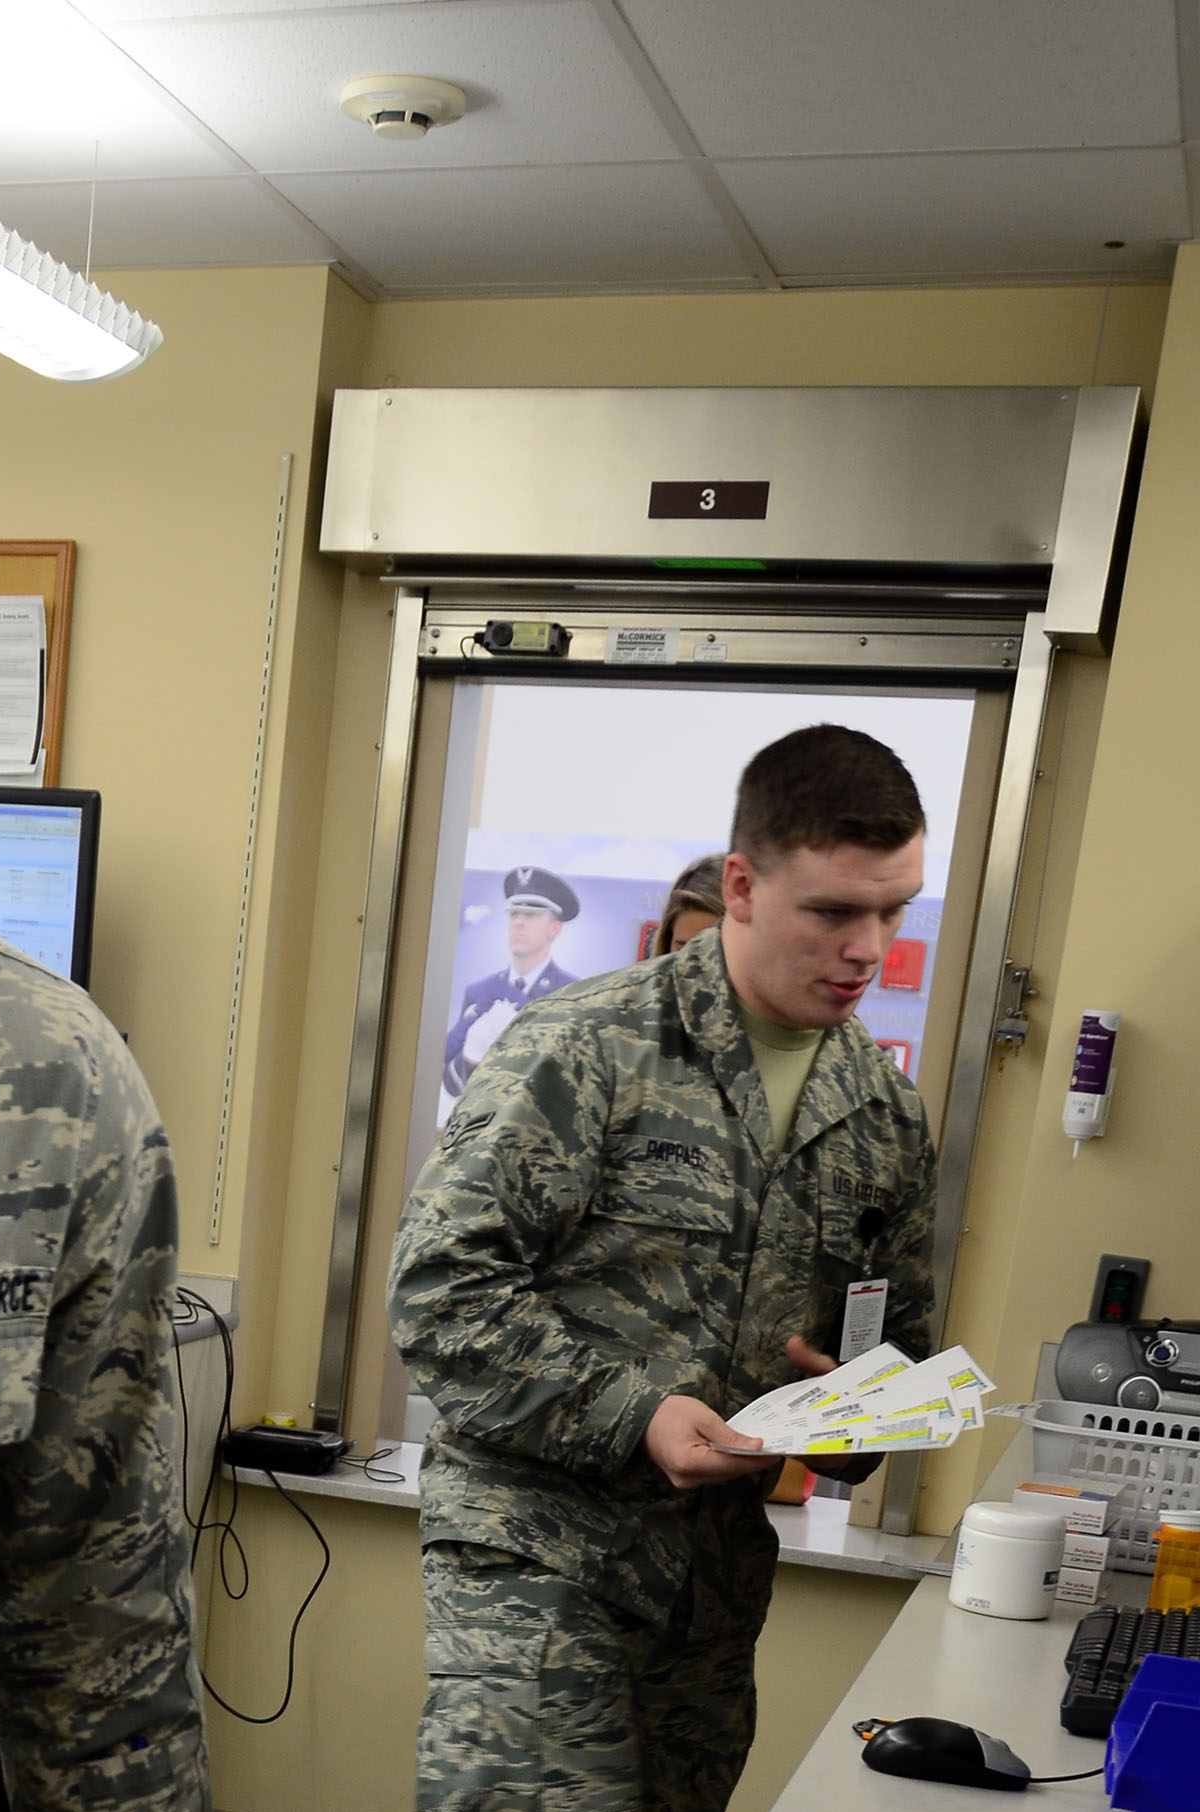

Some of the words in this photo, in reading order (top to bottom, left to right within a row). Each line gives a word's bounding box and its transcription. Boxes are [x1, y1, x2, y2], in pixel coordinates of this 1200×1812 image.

[700, 488, 716, 511] 3
[617, 632, 666, 641] McCORMICK
[647, 1140, 701, 1167] PAPPAS
